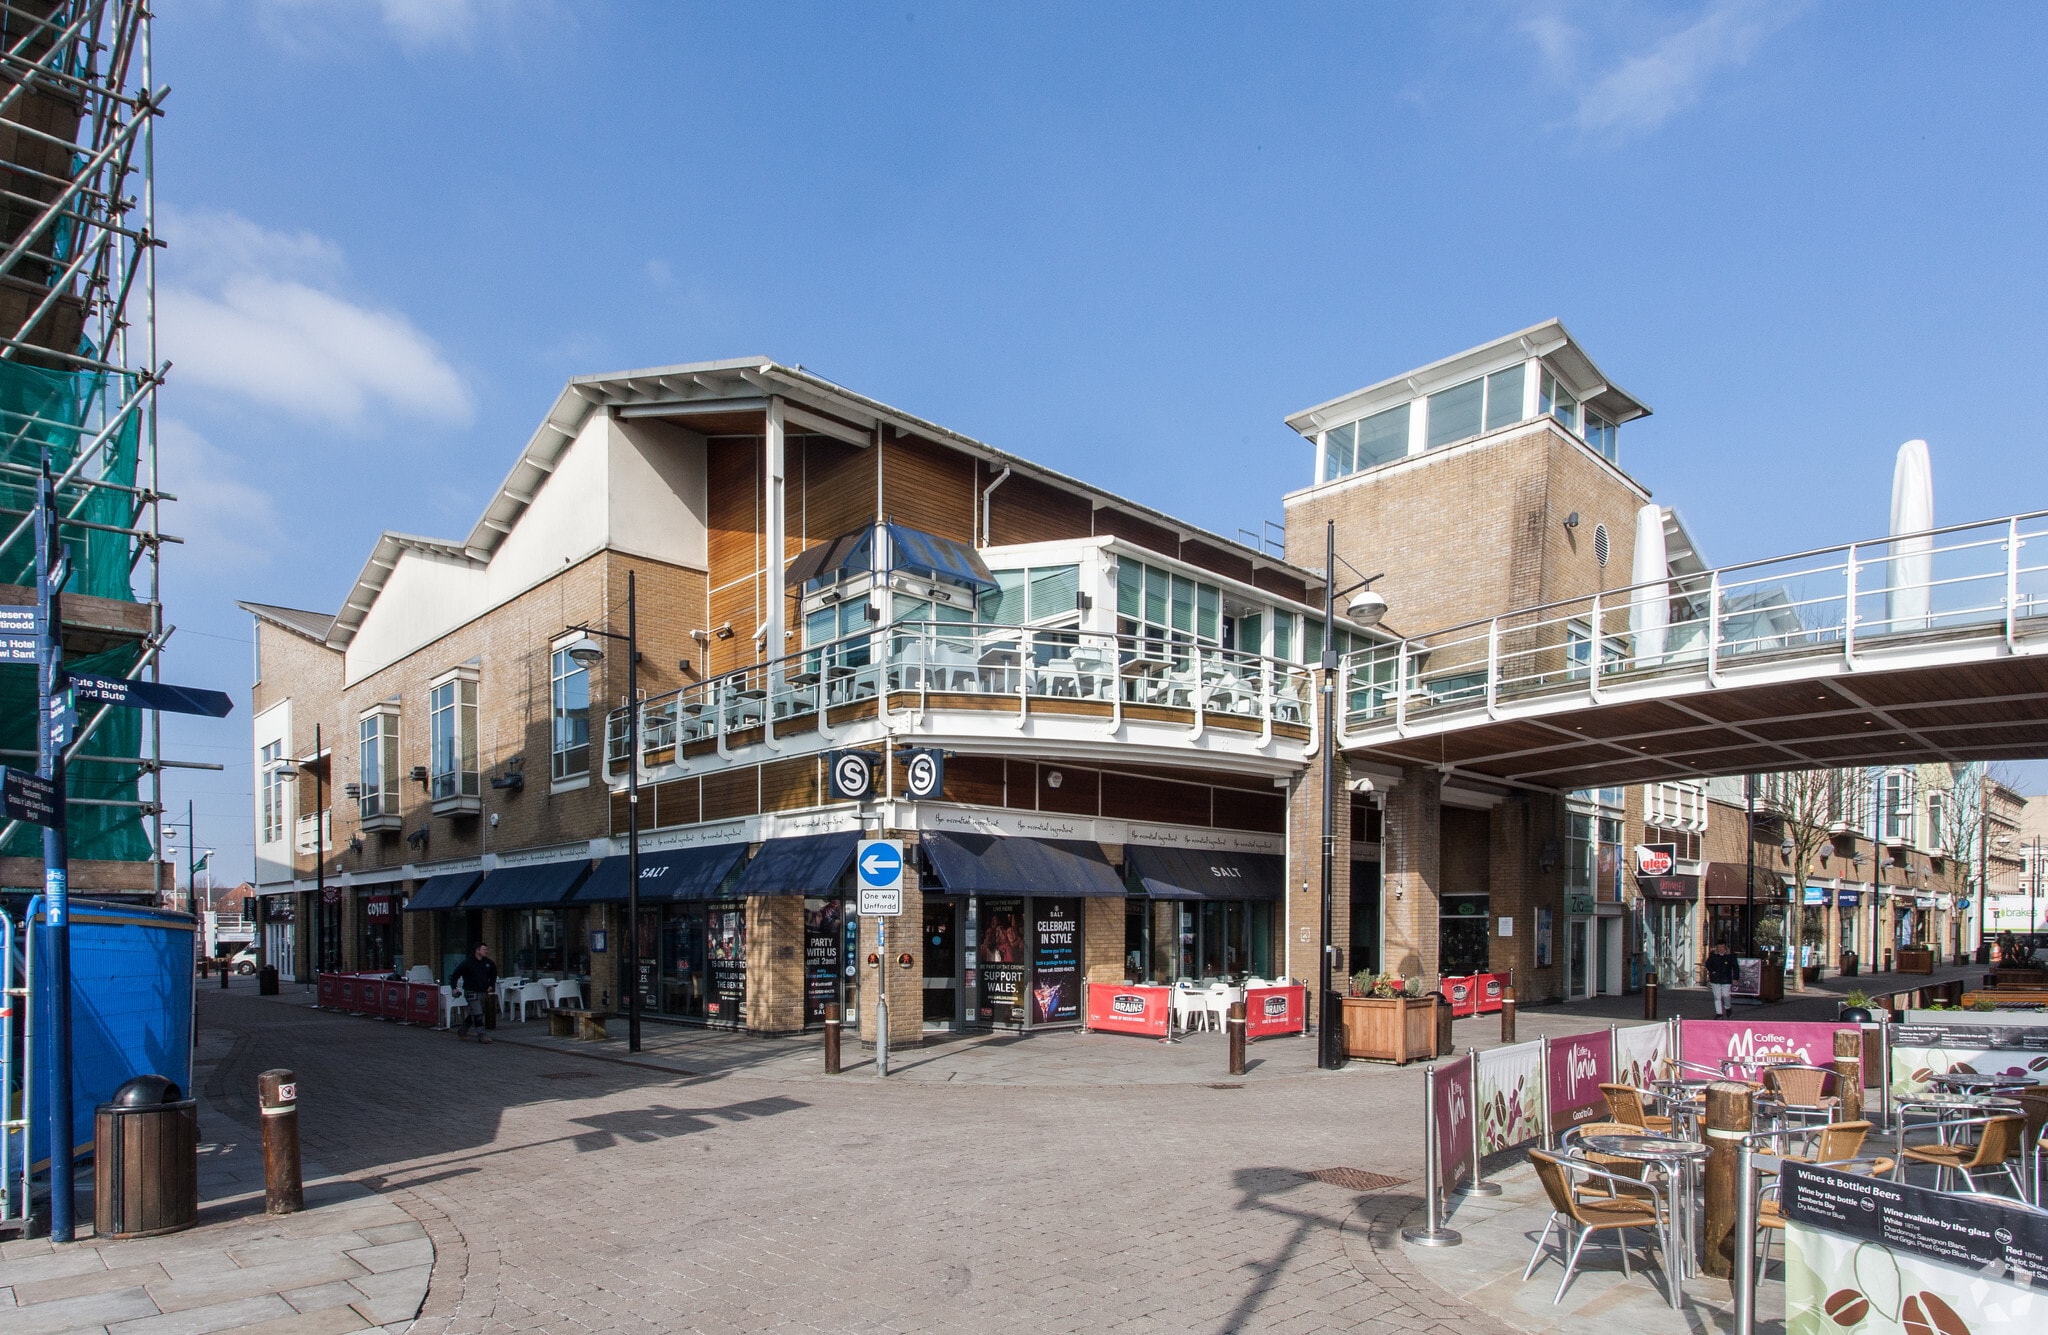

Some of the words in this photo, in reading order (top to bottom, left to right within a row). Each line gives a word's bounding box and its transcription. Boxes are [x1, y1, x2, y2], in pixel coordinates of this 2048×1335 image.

[10, 640, 35, 648] Hotel
[13, 650, 36, 658] Sant
[96, 680, 129, 692] Street
[101, 690, 126, 700] Bute
[1642, 859, 1668, 870] glee
[639, 866, 669, 878] SALT
[1210, 866, 1242, 878] SALT
[2006, 907, 2038, 918] brakes
[1037, 921, 1076, 931] CELEBRATE
[810, 938, 833, 947] PARTY
[1041, 933, 1049, 944] IN
[1050, 933, 1072, 944] STYLE
[807, 948, 825, 956] WITH
[827, 948, 836, 956] US
[984, 971, 1022, 981] SUPPORT
[717, 981, 726, 989] THE
[988, 983, 1019, 993] WALES.
[1115, 1003, 1142, 1012] BRAINS
[1265, 1004, 1285, 1013] BRAINS
[1754, 1033, 1785, 1042] Coffee
[1576, 1046, 1588, 1057] Coffee
[1567, 1042, 1596, 1100] Mania
[1573, 1109, 1583, 1120] Good
[1587, 1107, 1593, 1116] Go
[1798, 1169, 1825, 1184] Wines
[1826, 1176, 1835, 1186] &
[1836, 1179, 1871, 1194] Bottled
[1872, 1187, 1901, 1201] Beers
[1798, 1185, 1815, 1195] Wine
[1815, 1189, 1824, 1199] by
[1824, 1191, 1836, 1201] the
[1836, 1194, 1858, 1207] bottle
[1824, 1201, 1836, 1210] Bay
[1807, 1205, 1826, 1216] Medium
[1832, 1211, 1846, 1220] Blush
[1883, 1207, 1904, 1217] Wine
[1904, 1213, 1940, 1226] available
[1940, 1220, 1952, 1230] by
[1952, 1223, 1967, 1233] the
[1967, 1227, 1990, 1238] glass
[1883, 1216, 1903, 1227] White
[1904, 1222, 1920, 1231] 187ml
[1917, 1233, 1947, 1246] Sauvignon
[1884, 1232, 1899, 1241] Pinot
[1916, 1241, 1932, 1250] Pinot
[1970, 1254, 1996, 1268] Riesling
[2005, 1245, 2023, 1256] Red
[2024, 1251, 2043, 1261] 187ml
[2005, 1263, 2036, 1277] Cabernet
